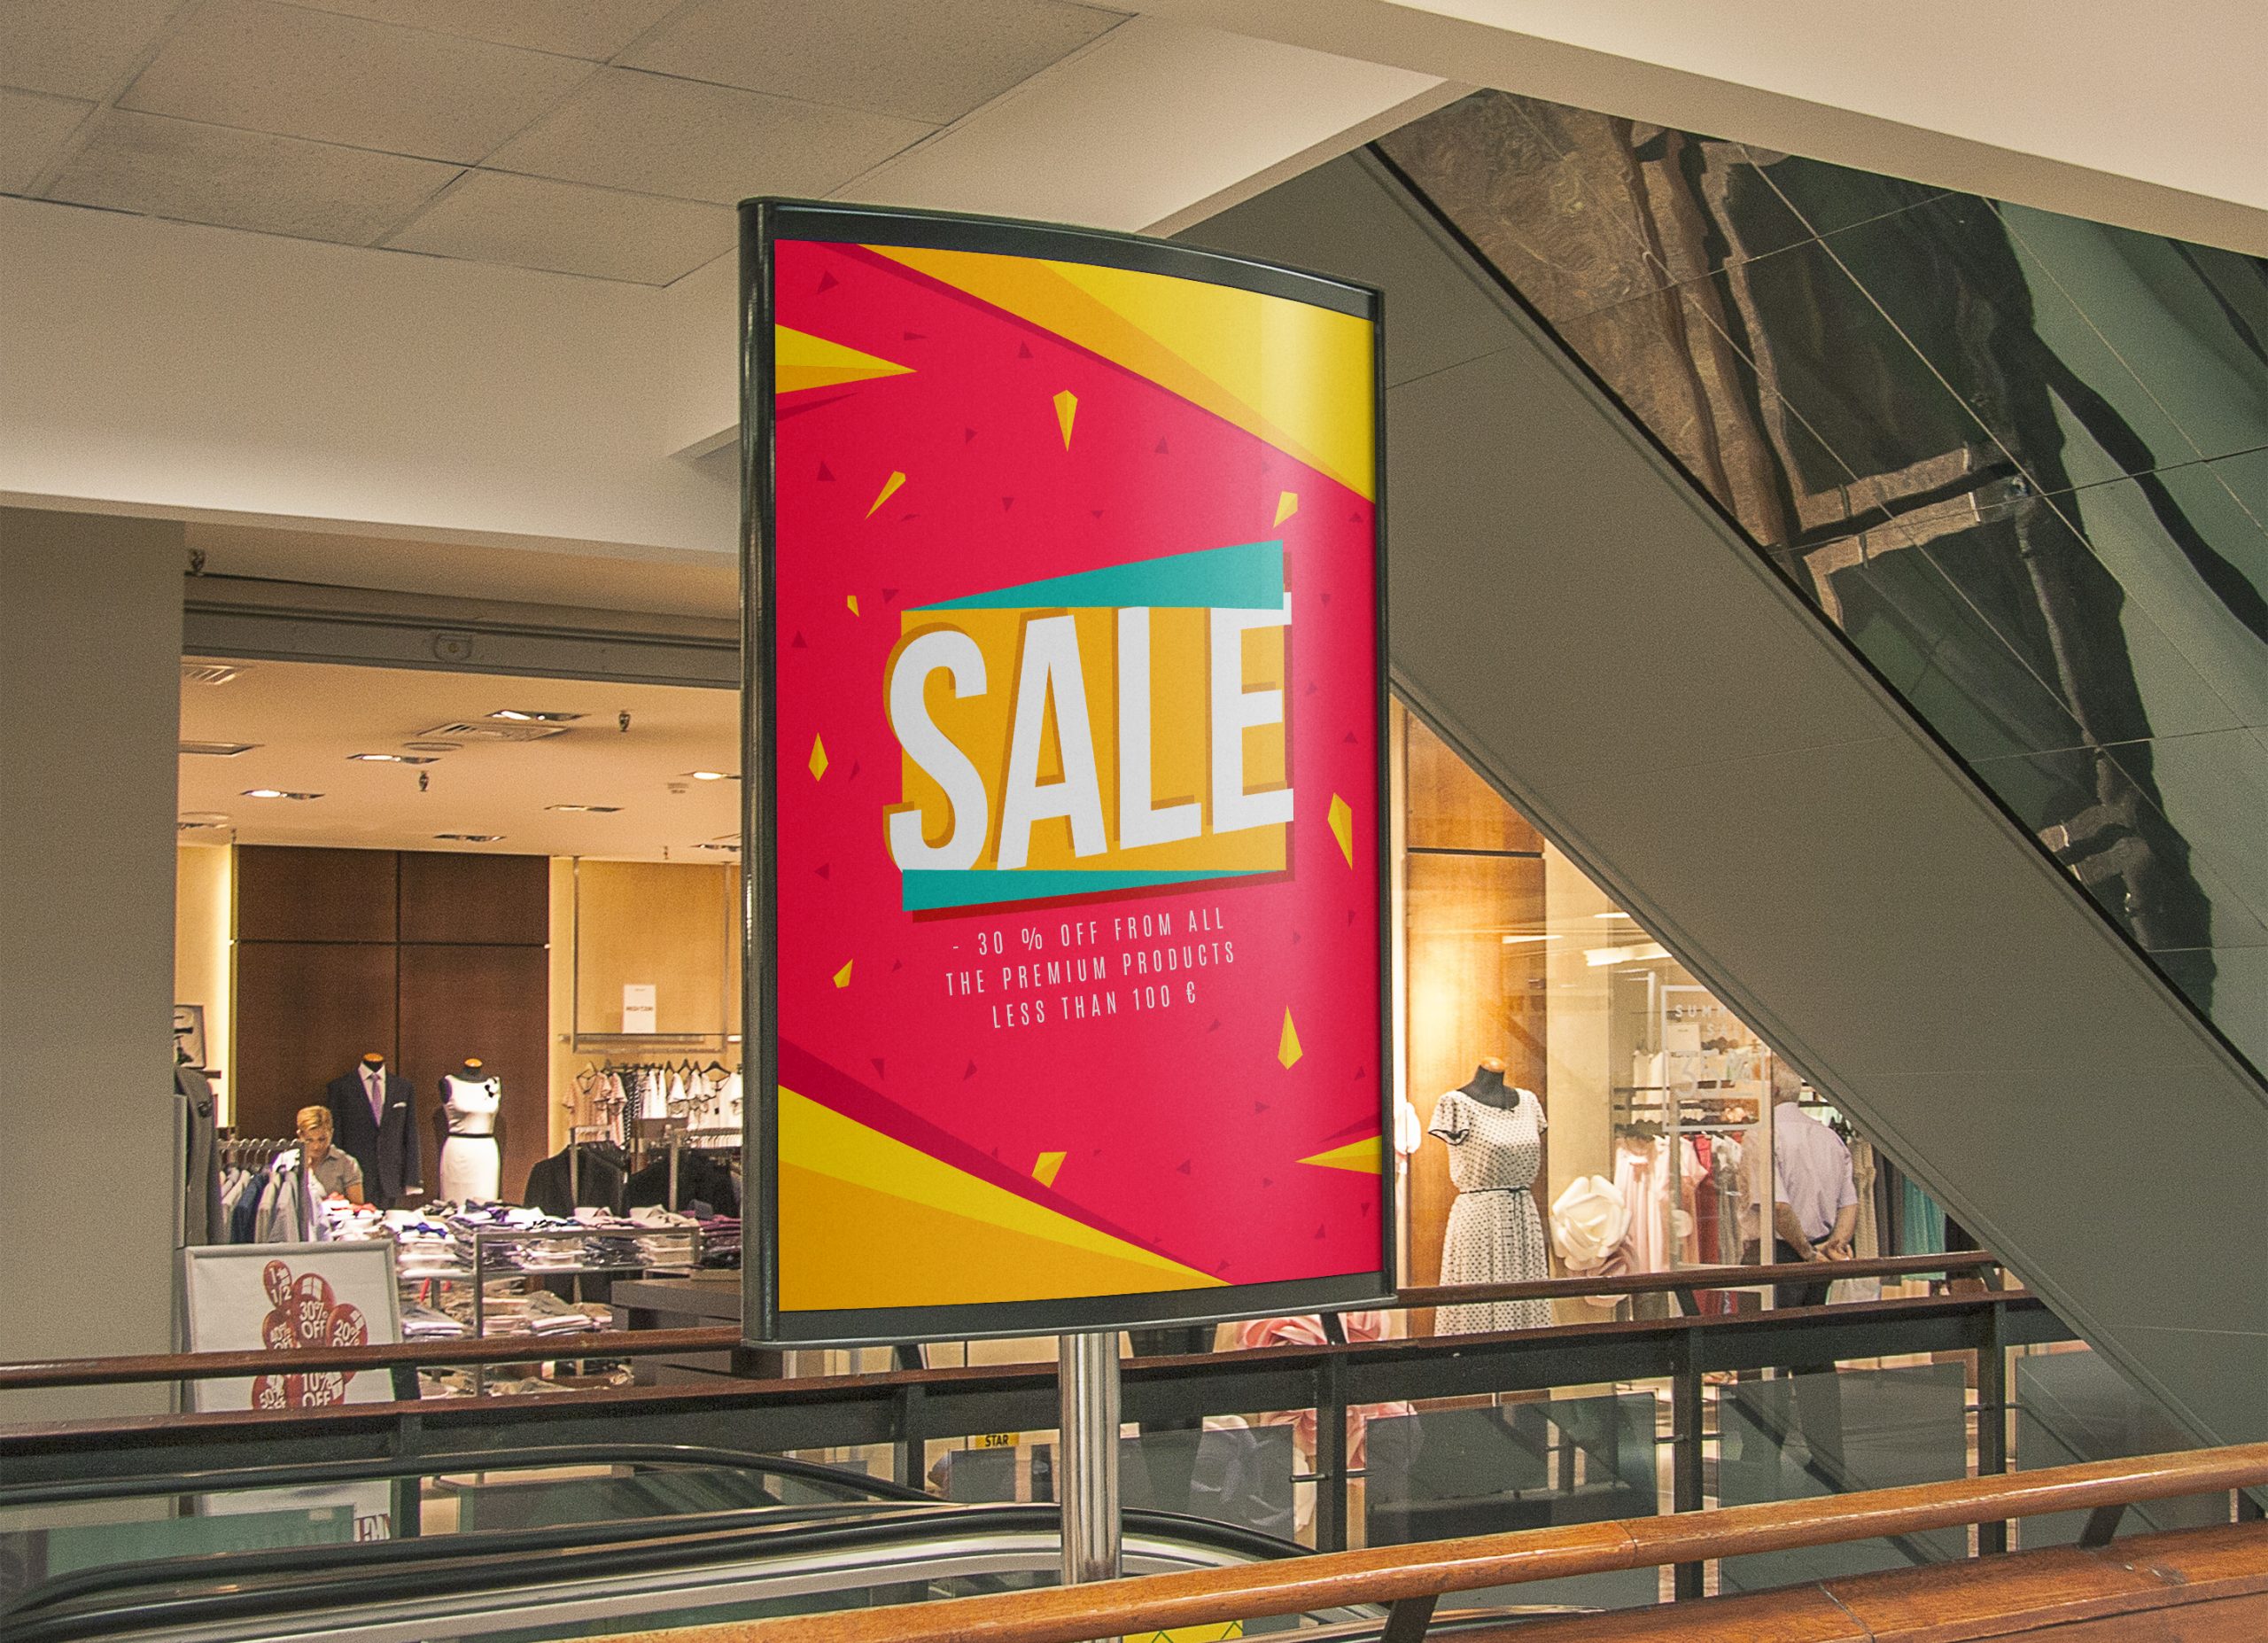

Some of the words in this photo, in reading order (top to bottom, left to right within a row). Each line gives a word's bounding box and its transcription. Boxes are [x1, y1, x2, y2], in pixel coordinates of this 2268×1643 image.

[889, 592, 1294, 873] SALE
[978, 931, 1003, 955] 30
[1021, 927, 1043, 951] %
[1060, 922, 1097, 946] OFF
[1115, 913, 1171, 941] FROM
[1188, 907, 1223, 932] ALL
[945, 969, 984, 996] THE
[1003, 956, 1106, 990] PREMIUM
[1122, 941, 1234, 976] PRODUCTS
[993, 1000, 1045, 1029] LESS
[1061, 991, 1117, 1020] THAN
[1133, 985, 1170, 1010] 100
[1186, 981, 1196, 1003] €
[299, 1300, 329, 1322] 30%
[301, 1320, 326, 1339] OFF
[333, 1320, 361, 1342] 20%
[985, 1434, 1009, 1446] STAR
